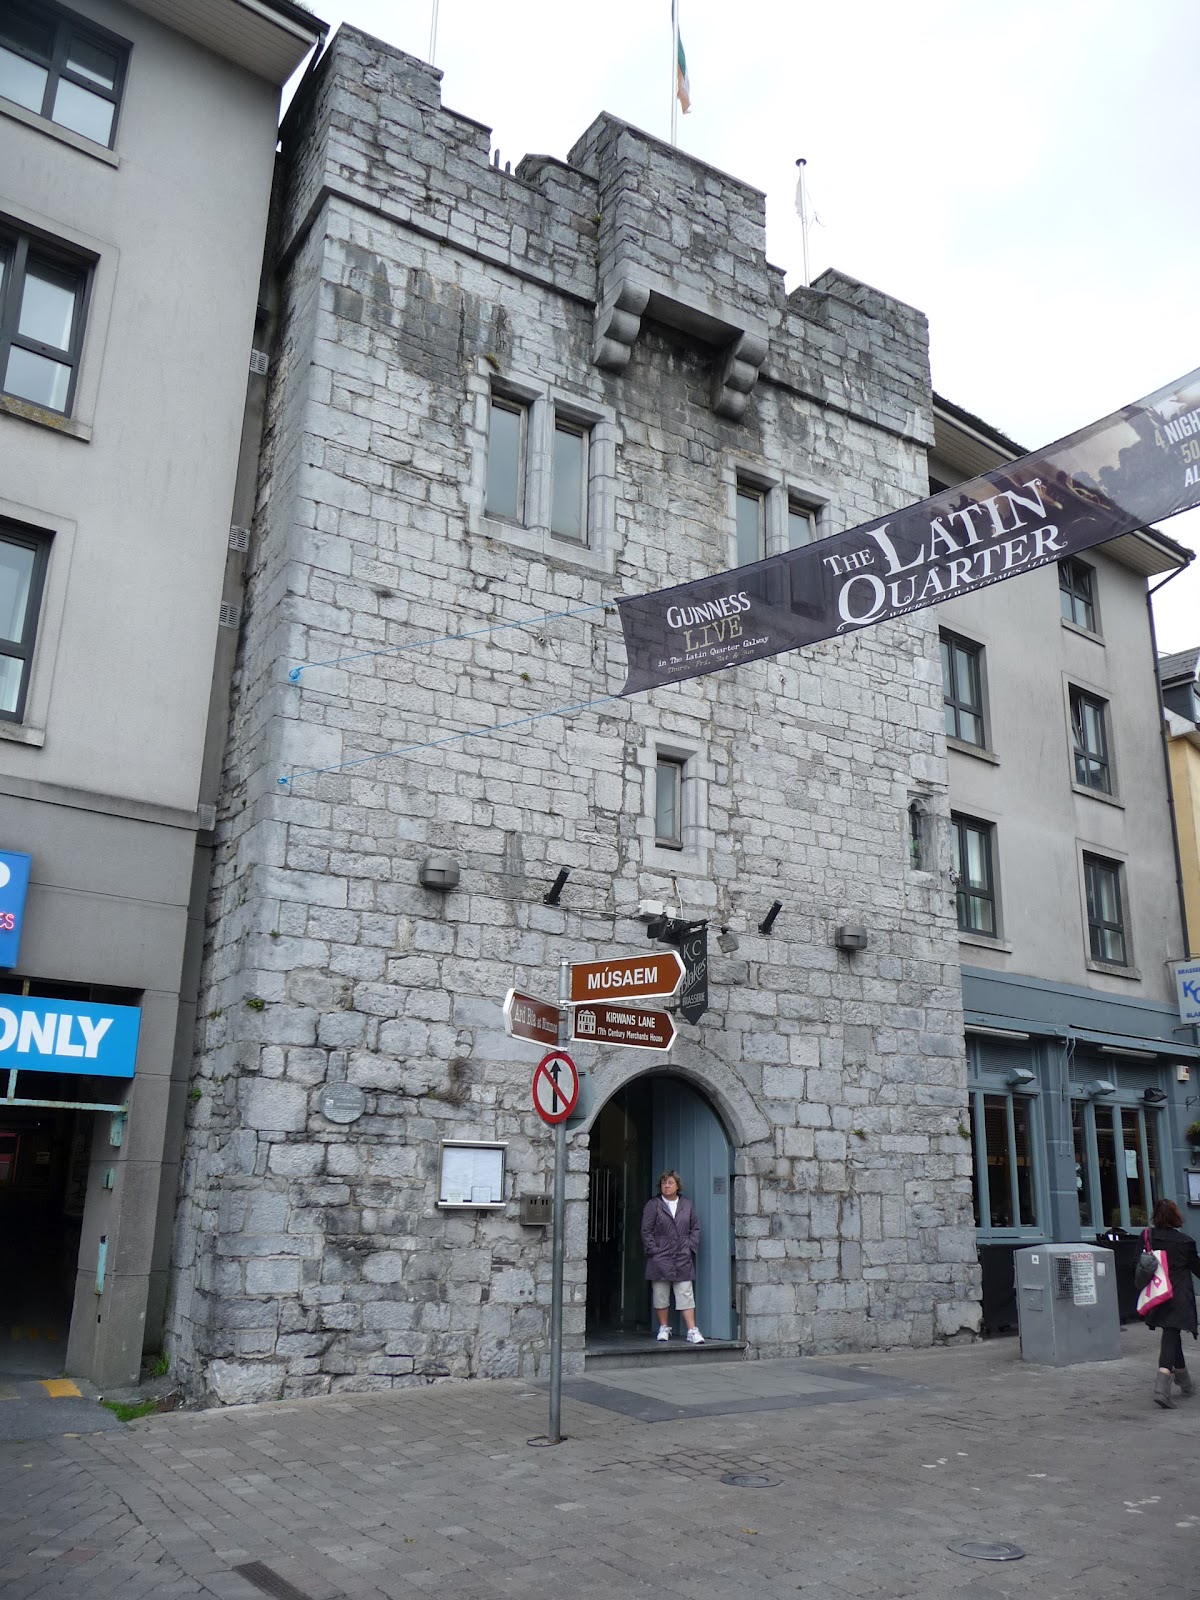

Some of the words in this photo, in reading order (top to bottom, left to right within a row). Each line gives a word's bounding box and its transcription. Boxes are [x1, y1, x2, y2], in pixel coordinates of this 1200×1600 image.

[1154, 428, 1165, 448] 4
[1181, 439, 1200, 464] 50
[666, 591, 751, 628] GUINNESS
[683, 614, 743, 652] LIVE
[670, 656, 683, 664] The
[685, 650, 707, 661] Latin
[710, 644, 740, 655] Quarter
[742, 636, 769, 648] Galway
[587, 966, 658, 990] MÚSAEM
[1177, 966, 1200, 975] BRASSE
[605, 1011, 636, 1026] KIRWANS
[638, 1016, 656, 1029] LANE
[0, 1007, 114, 1059] ONLY
[597, 1027, 607, 1036] 17th
[607, 1028, 626, 1040] Century
[626, 1031, 649, 1041] Merchants
[649, 1034, 663, 1043] House
